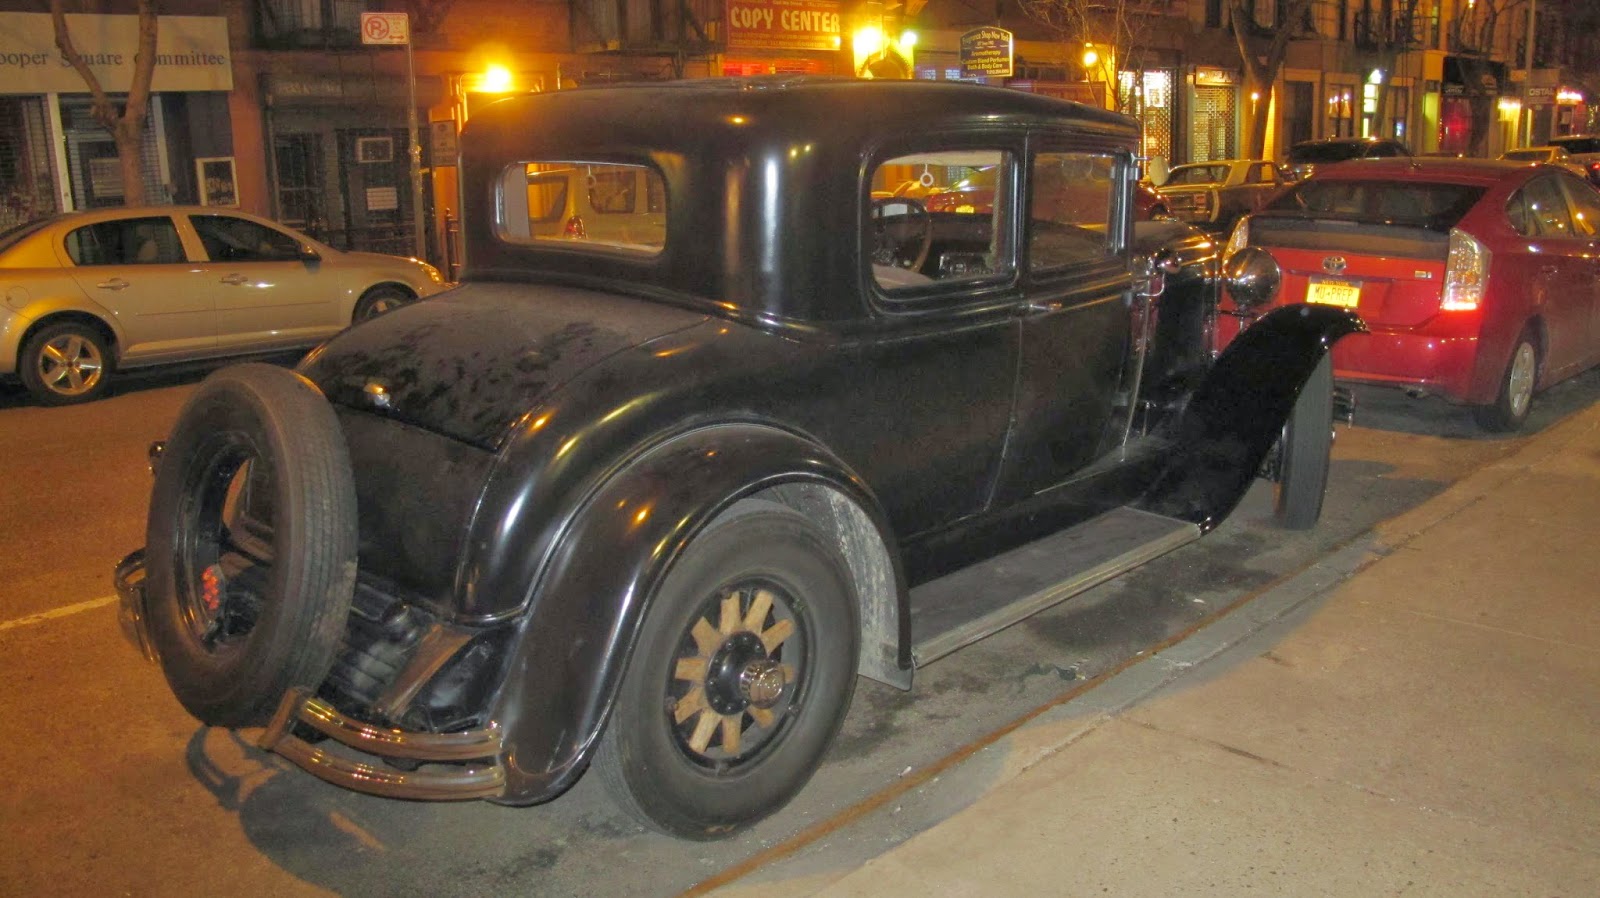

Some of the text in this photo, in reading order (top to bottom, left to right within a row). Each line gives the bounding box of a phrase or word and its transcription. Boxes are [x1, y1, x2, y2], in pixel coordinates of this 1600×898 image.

[731, 6, 841, 33] COPY CENTER
[0, 53, 48, 68] ooper
[61, 52, 123, 68] Suare
